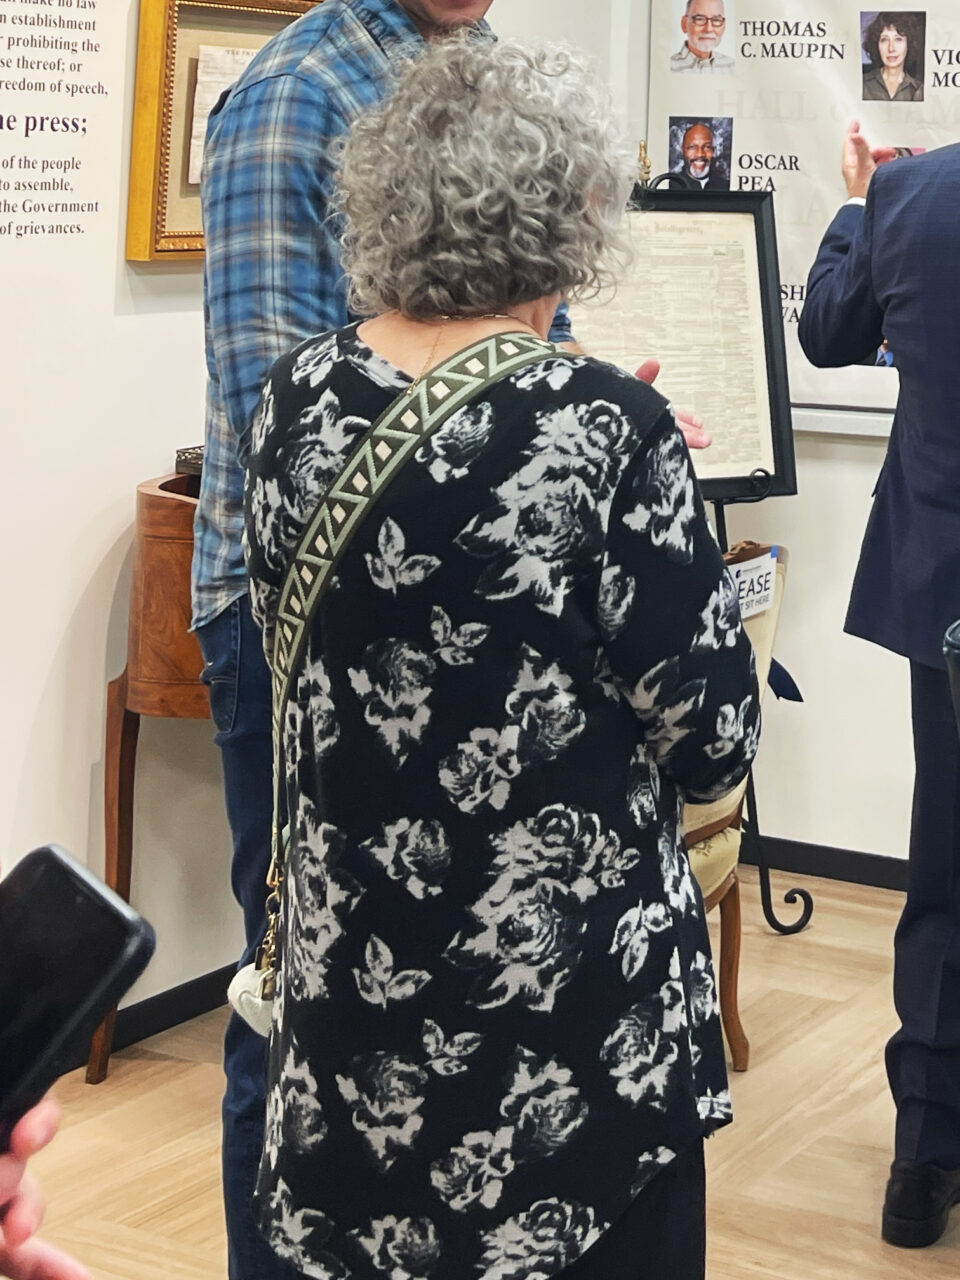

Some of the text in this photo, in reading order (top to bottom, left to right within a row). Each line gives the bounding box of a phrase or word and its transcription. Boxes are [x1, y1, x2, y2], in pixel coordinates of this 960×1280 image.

[11, 13, 96, 31] establishment
[740, 21, 827, 38] THOMAS
[7, 34, 101, 54] prohibiting the
[740, 43, 846, 60] C. MAUPIN
[0, 55, 83, 73] se thereof; or
[49, 79, 63, 93] of
[65, 81, 109, 97] speech,
[24, 114, 87, 137] press;
[1, 155, 82, 173] of the people
[738, 153, 801, 171] OSCAR
[14, 178, 74, 193] assemble,
[737, 175, 776, 192] PEA
[22, 199, 99, 213] Government
[0, 221, 85, 239] of grievances.
[738, 572, 771, 599] EASE
